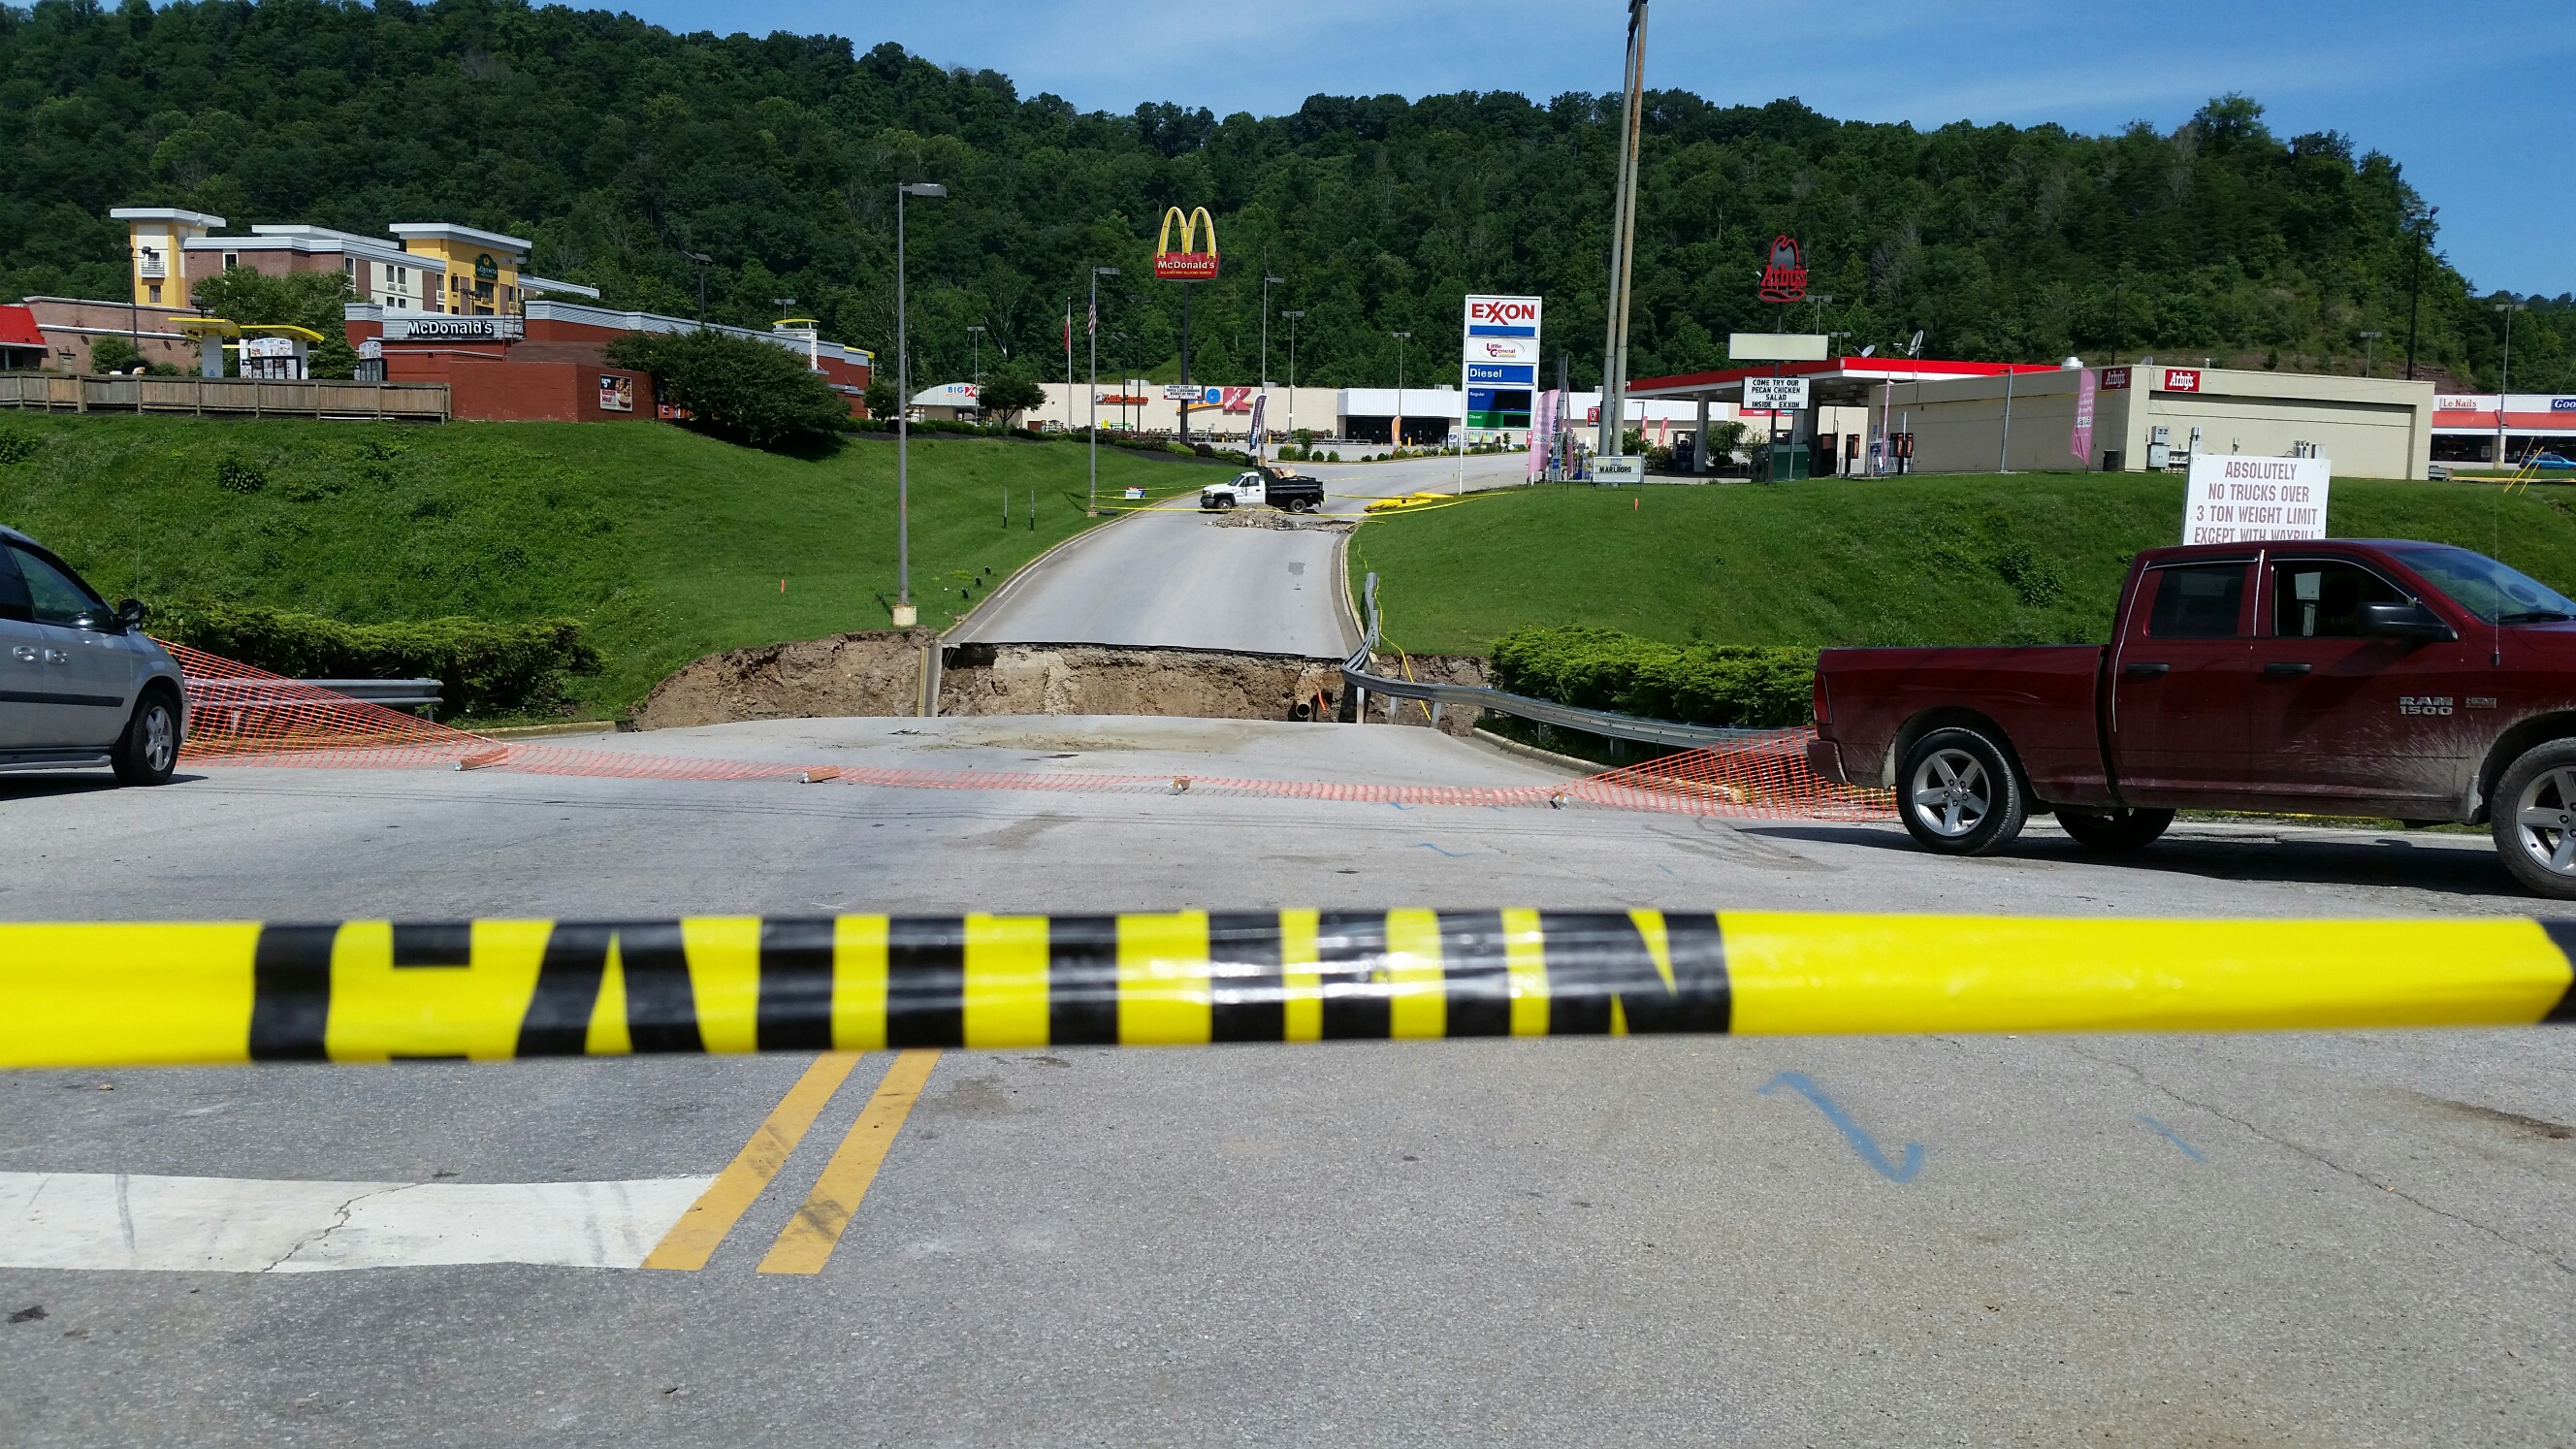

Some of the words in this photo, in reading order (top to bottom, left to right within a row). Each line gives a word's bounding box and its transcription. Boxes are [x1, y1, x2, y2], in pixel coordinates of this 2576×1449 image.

[1157, 261, 1215, 270] McDonald's
[1760, 263, 1807, 292] Arby's
[1471, 301, 1535, 326] EXXON
[407, 321, 494, 336] McDonald's
[1490, 348, 1516, 358] General
[1469, 368, 1502, 378] Diesel
[2106, 370, 2126, 388] Arby's
[2169, 371, 2195, 390] Arby's
[2443, 399, 2453, 407] Le
[2455, 399, 2477, 407] Nails
[2225, 461, 2297, 480] ABSOLUTELY
[2208, 483, 2225, 500] NO
[2231, 483, 2276, 501] TRUCKS
[2281, 485, 2309, 502] OVER
[2196, 504, 2205, 522] 3
[2210, 505, 2234, 523] TON
[2238, 506, 2282, 524] WEIGHT
[2287, 507, 2318, 526] LIMIT
[2194, 527, 2236, 544] EXCEPT
[2240, 528, 2267, 542] WITH
[2399, 696, 2453, 705] RAM
[2399, 706, 2453, 715] 1500
